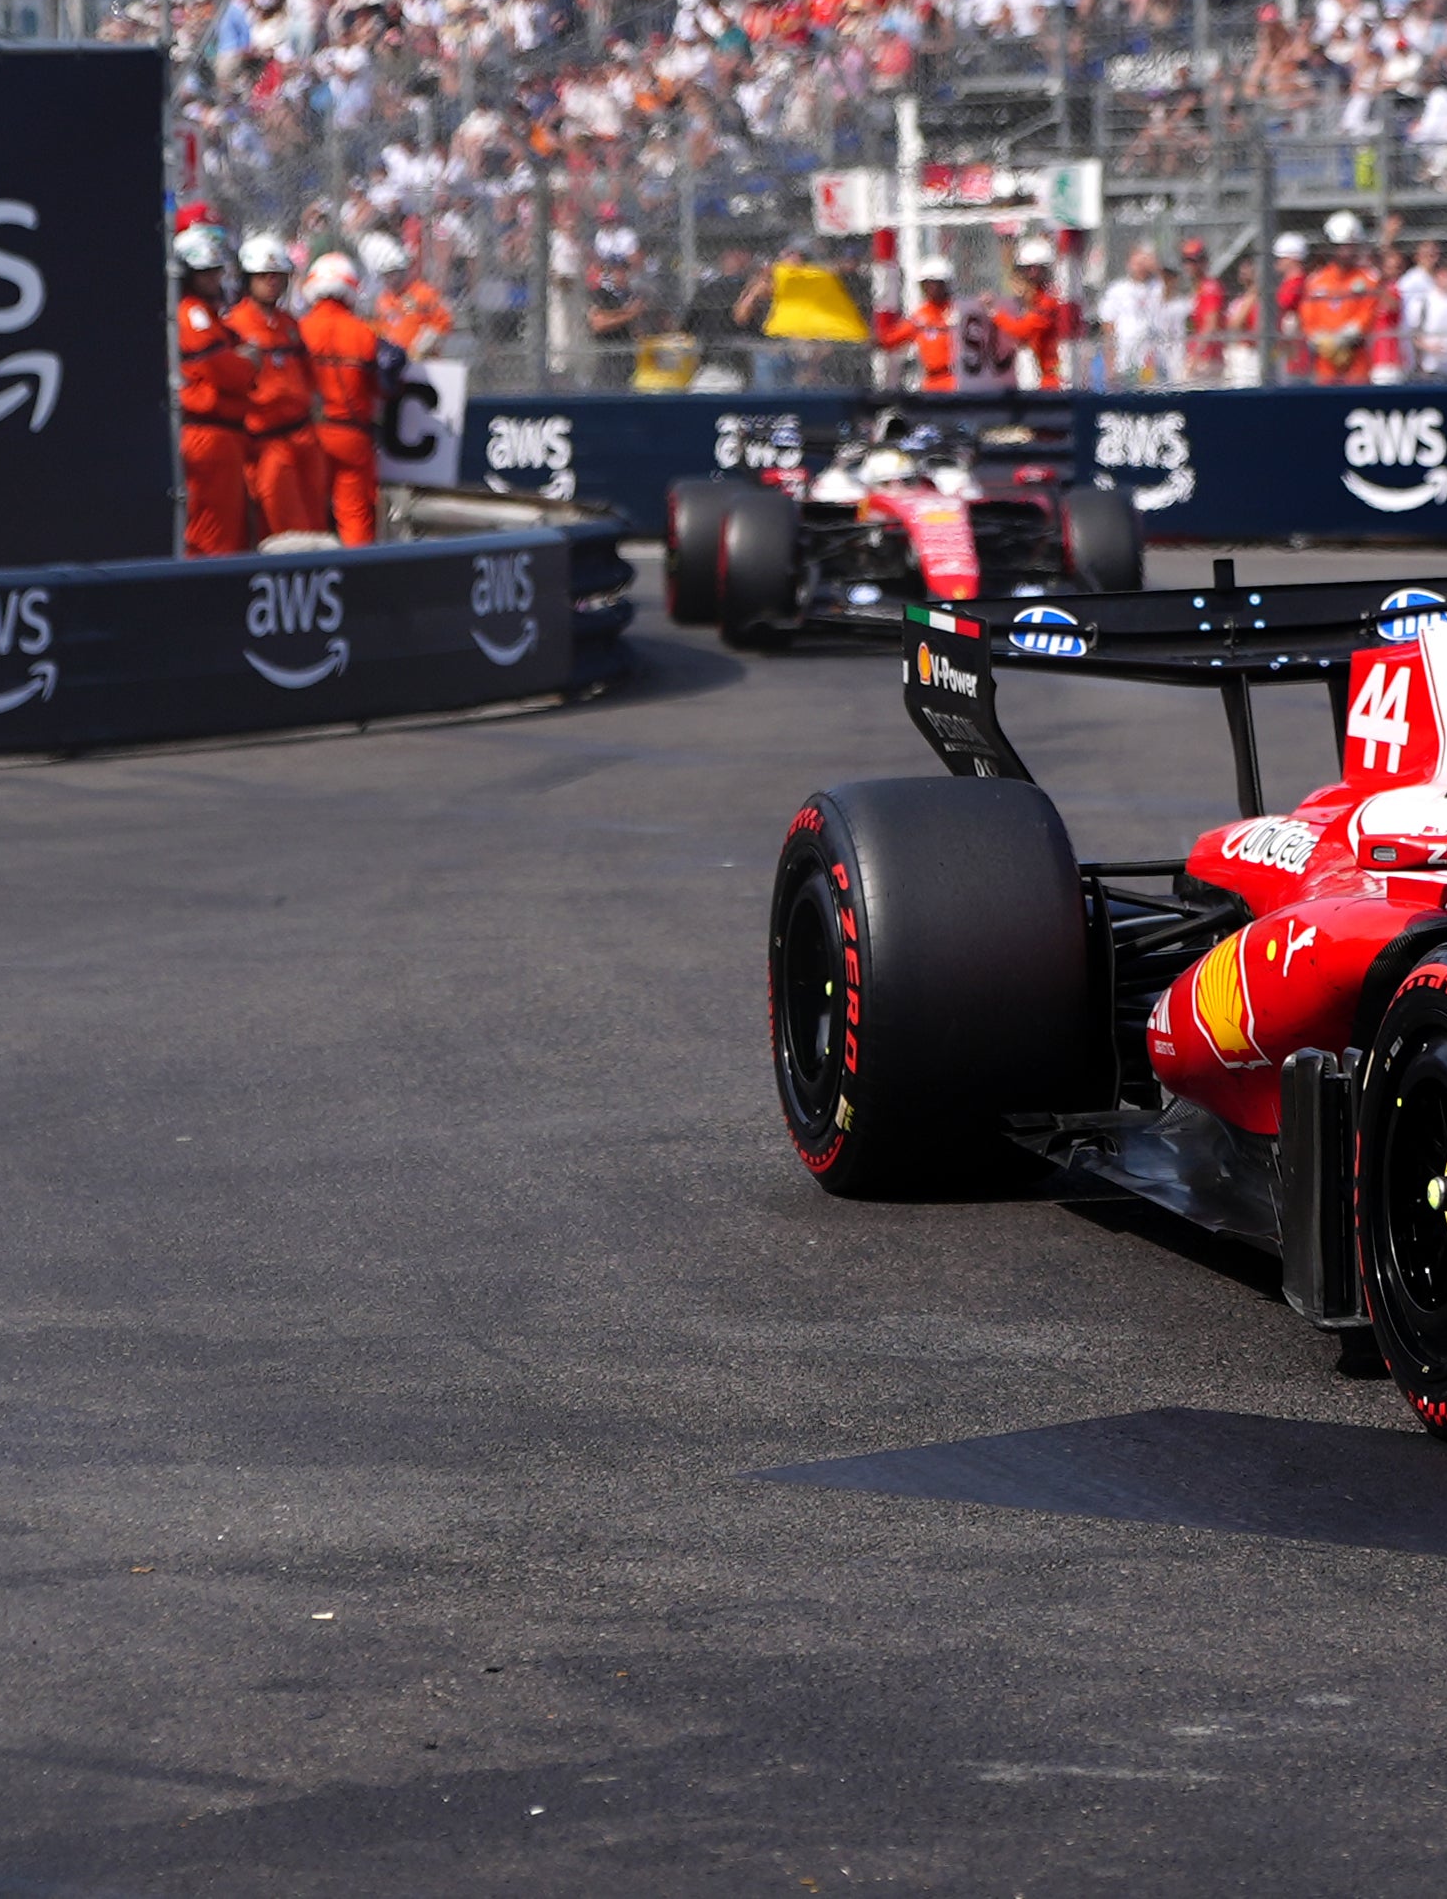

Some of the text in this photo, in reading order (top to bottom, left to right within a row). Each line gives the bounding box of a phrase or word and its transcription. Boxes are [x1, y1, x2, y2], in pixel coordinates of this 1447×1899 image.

[385, 382, 440, 464] C
[486, 415, 572, 470] aws
[1095, 411, 1191, 469] aws
[1344, 407, 1447, 468] aws
[247, 568, 344, 638] aws
[471, 551, 534, 618] aws
[929, 653, 978, 699] V-Power
[1348, 662, 1412, 774] 44
[831, 863, 861, 1075] P ZERO
